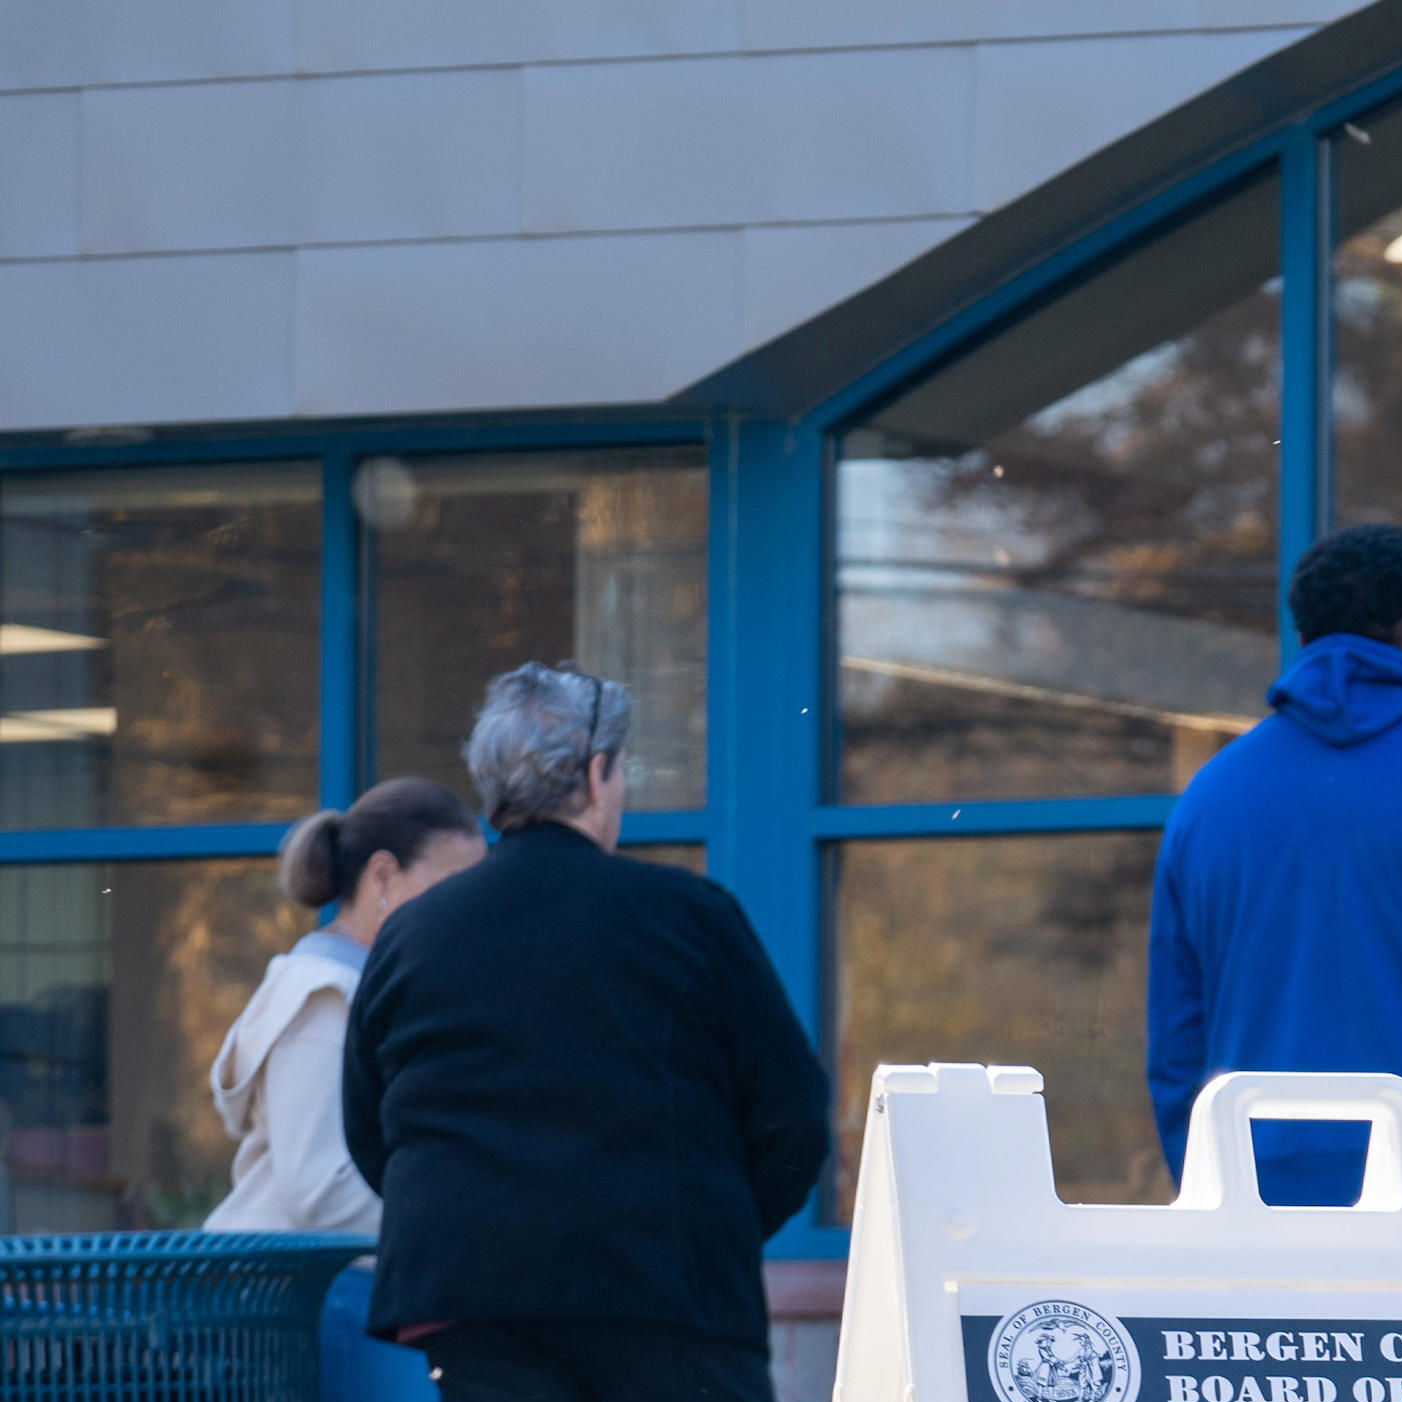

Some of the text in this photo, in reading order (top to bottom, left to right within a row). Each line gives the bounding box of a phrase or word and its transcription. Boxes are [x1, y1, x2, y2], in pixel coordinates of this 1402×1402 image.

[999, 1304, 1127, 1371] SEAL OF BERGEN COUNTY
[1161, 1331, 1364, 1361] BERGEN
